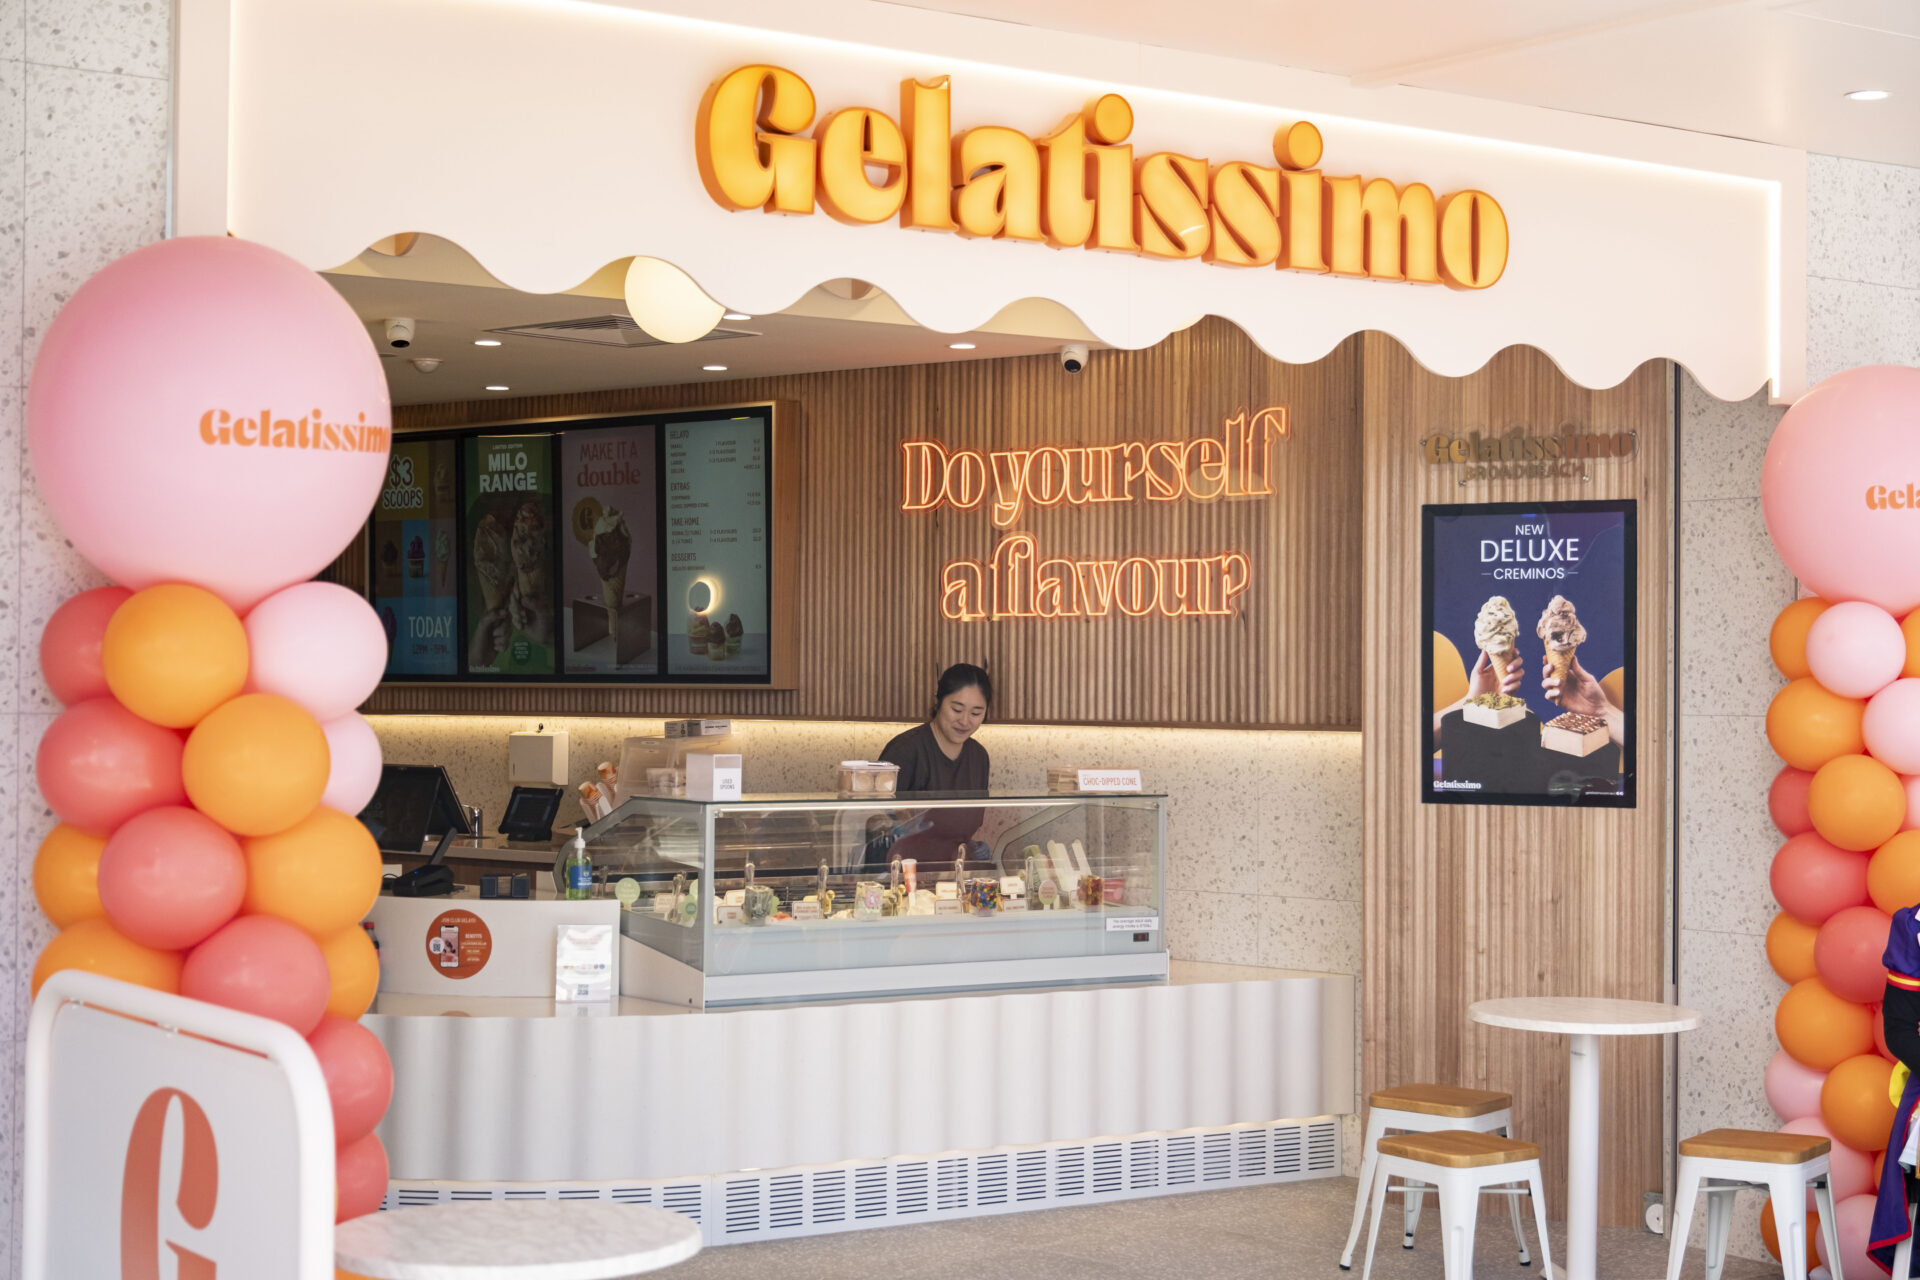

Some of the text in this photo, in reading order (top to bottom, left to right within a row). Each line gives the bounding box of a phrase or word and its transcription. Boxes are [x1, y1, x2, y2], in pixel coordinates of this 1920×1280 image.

[695, 64, 1510, 291] Gelatissimo
[579, 440, 639, 463] MAKE IT A
[1424, 424, 1633, 464] Gelatissimo
[389, 454, 415, 488] $3
[488, 452, 528, 473] MILO
[902, 407, 1288, 526] Do yourself
[1464, 462, 1585, 481] BROADBEACH
[479, 472, 538, 493] RANGE
[576, 462, 641, 488] double
[382, 488, 424, 510] SCOOPS
[1515, 524, 1545, 535] NEW
[1480, 538, 1579, 562] DELUXE
[942, 534, 1250, 619] a flavour
[1493, 567, 1565, 580] CREMINOS
[408, 616, 453, 638] TODAY
[1083, 777, 1138, 786] CHOC-DIPPED CONE
[1433, 780, 1482, 790] Gelatissimo
